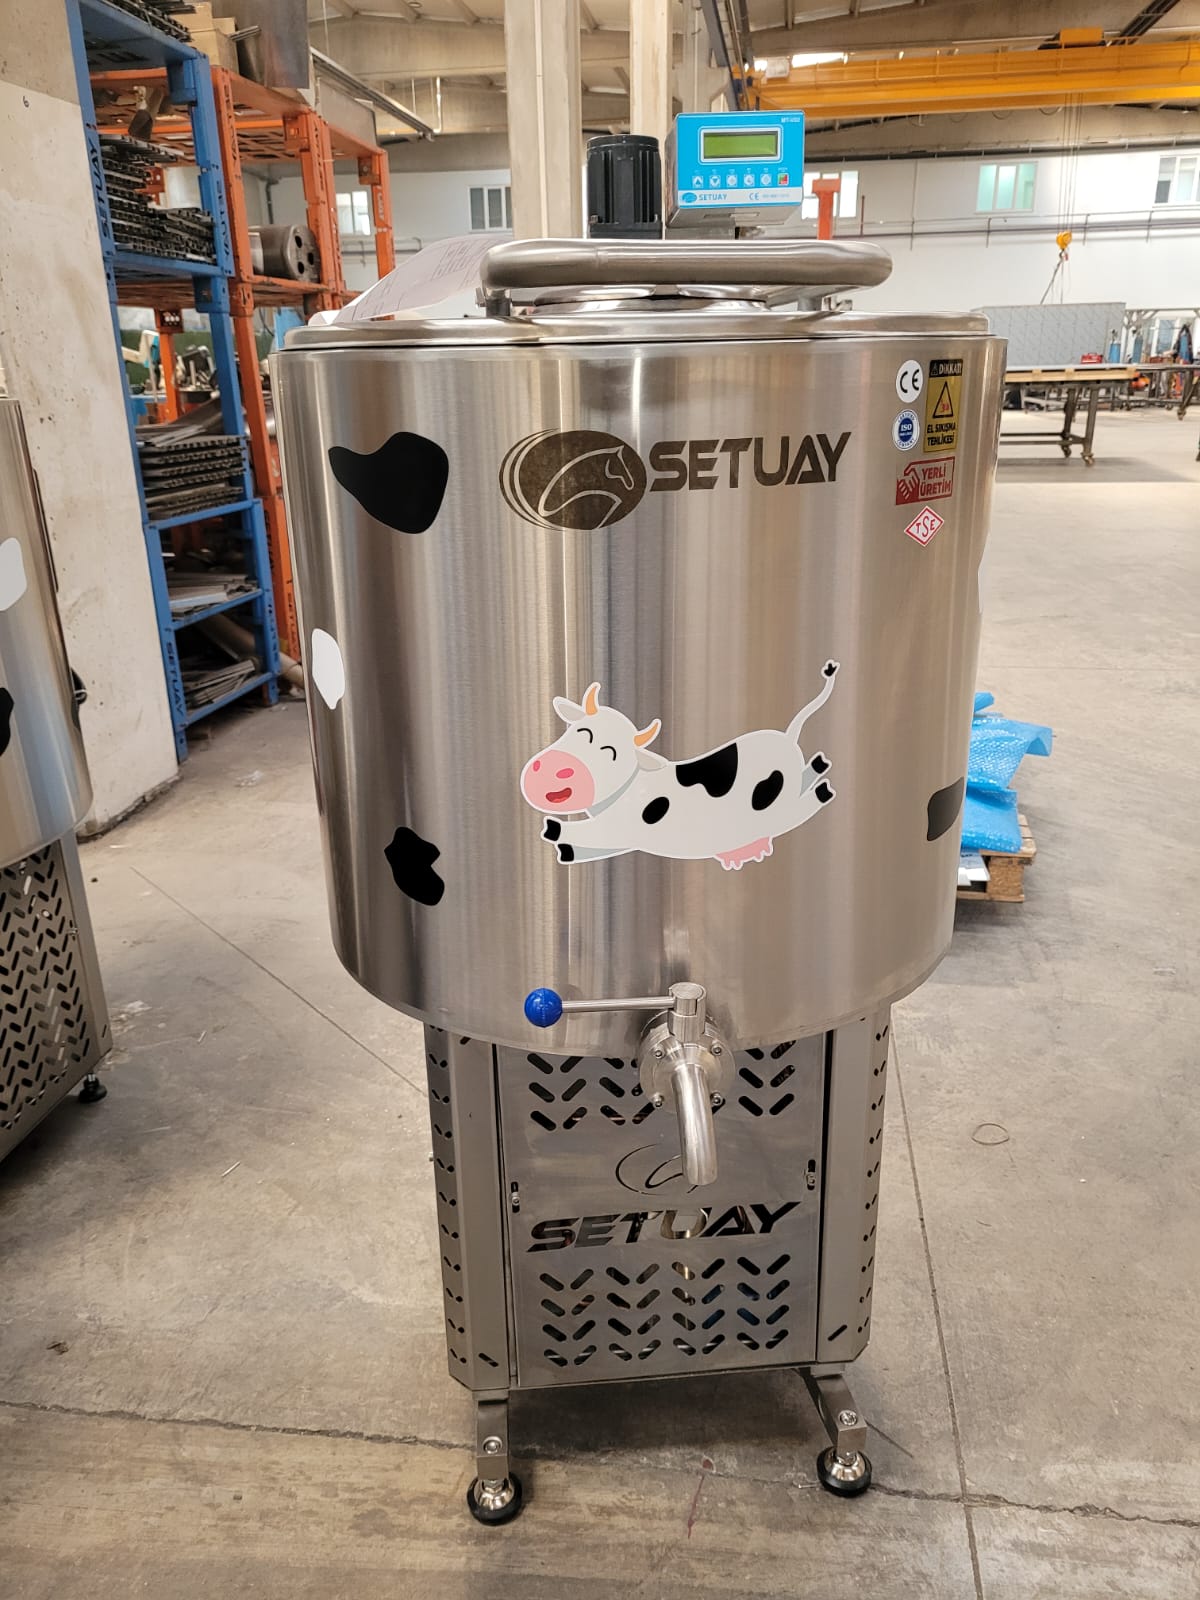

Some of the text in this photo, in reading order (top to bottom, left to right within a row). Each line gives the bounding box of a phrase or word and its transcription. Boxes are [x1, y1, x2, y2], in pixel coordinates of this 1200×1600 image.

[87, 137, 112, 240] SETUAY
[698, 193, 728, 201] SETUAY
[749, 192, 760, 201] CE
[900, 368, 920, 394] CE
[900, 423, 912, 432] ISO
[927, 424, 934, 433] EL
[649, 431, 852, 492] SETUAY
[922, 463, 947, 480] YERLİ
[920, 478, 952, 497] ÜRETİM
[916, 515, 935, 537] TSE
[526, 1201, 801, 1252] SETUAY
